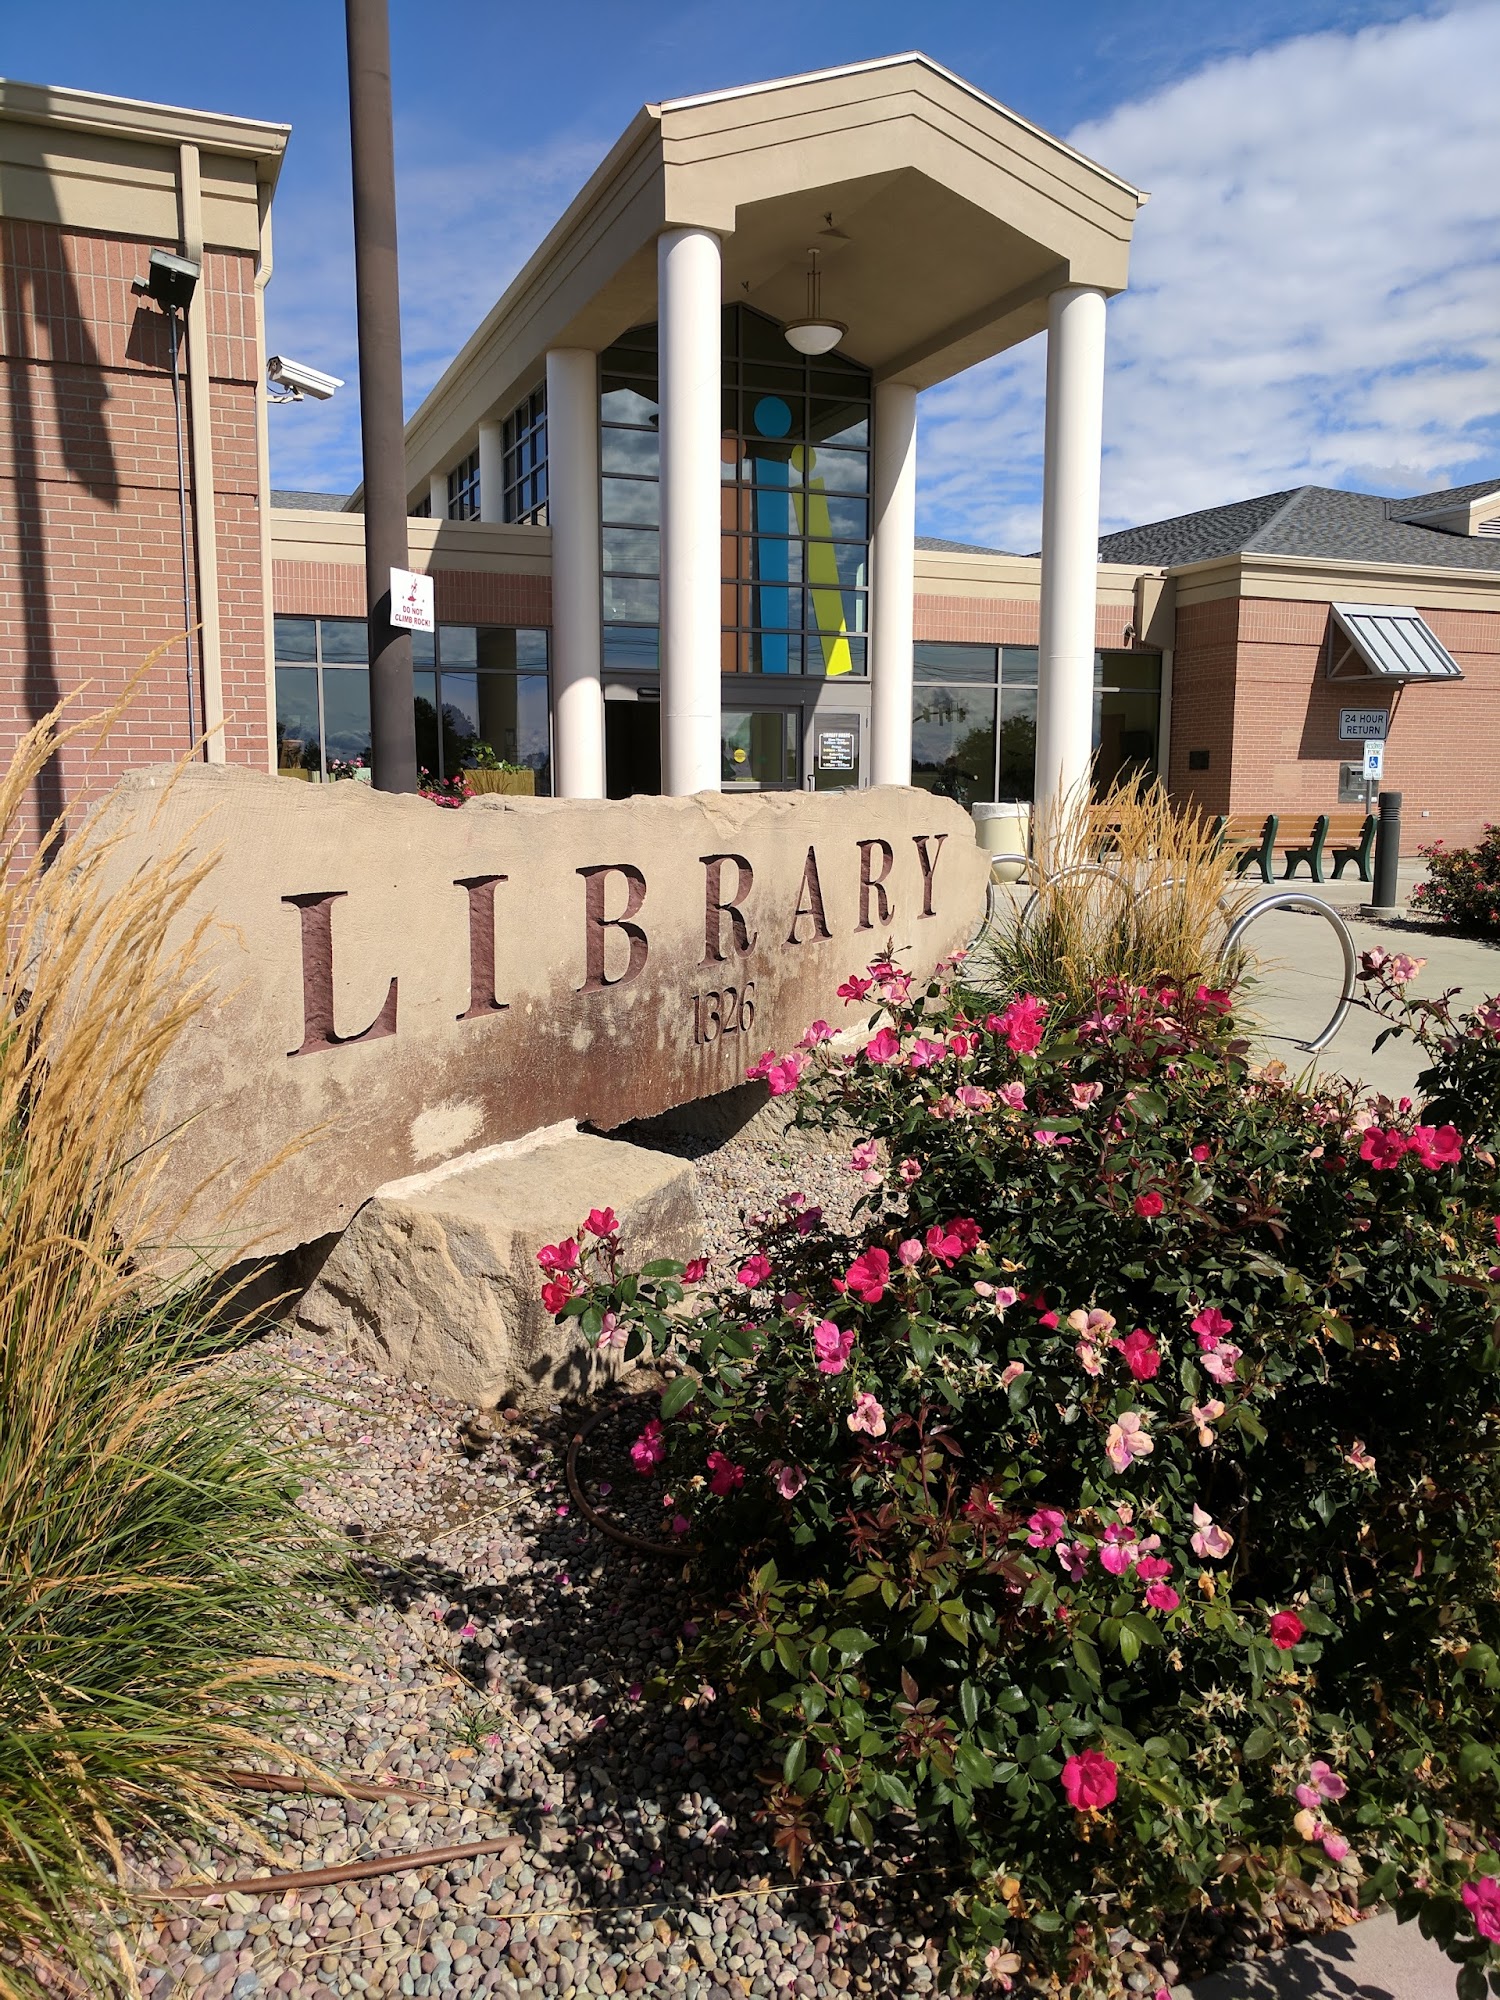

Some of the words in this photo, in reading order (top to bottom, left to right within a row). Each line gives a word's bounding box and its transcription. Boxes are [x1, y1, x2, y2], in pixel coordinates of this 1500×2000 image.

[402, 605, 411, 614] DO
[411, 608, 423, 616] NOT
[394, 613, 413, 624] CLIMB
[413, 617, 431, 627] ROCK!
[1345, 714, 1356, 723] 24
[1360, 714, 1384, 723] HOUR
[1346, 725, 1381, 735] RETURN
[280, 833, 950, 1058] LIBRARY
[691, 981, 755, 1045] 1326
